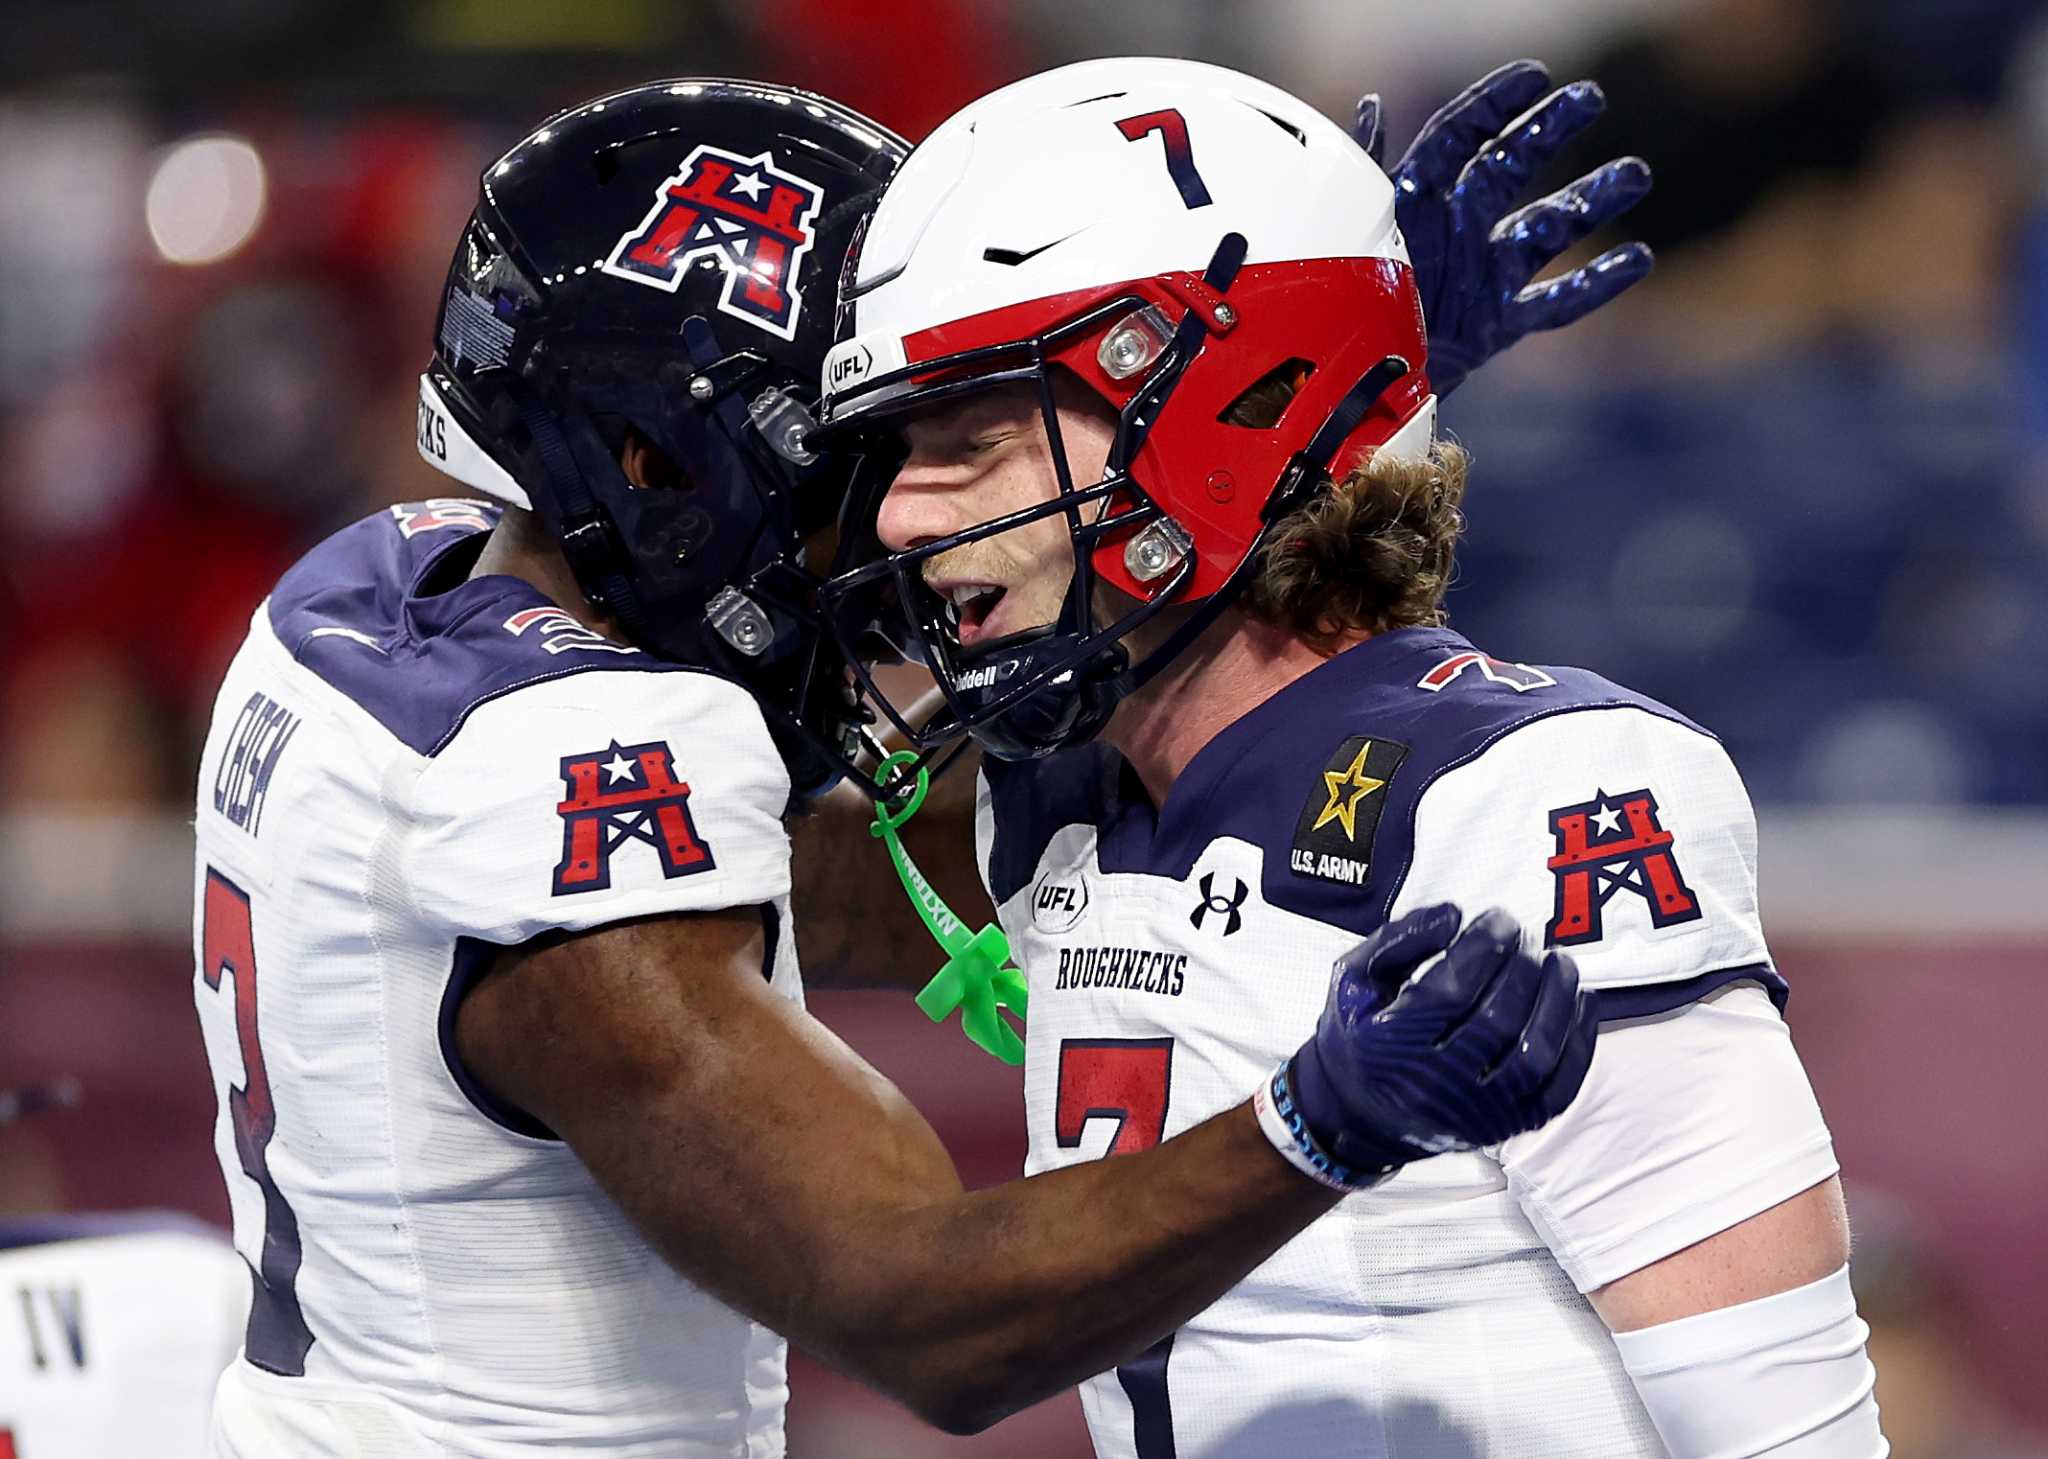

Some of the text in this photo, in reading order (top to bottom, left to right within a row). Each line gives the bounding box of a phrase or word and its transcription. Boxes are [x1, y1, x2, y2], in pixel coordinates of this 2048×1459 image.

[1113, 108, 1214, 210] 7
[834, 355, 863, 382] UFL
[1416, 652, 1558, 692] 7
[1291, 849, 1369, 885] U.S. ARMY
[1037, 886, 1076, 912] UFL
[1055, 946, 1188, 997] ROUGHNECKS
[202, 862, 317, 1377] 3
[17, 1280, 88, 1373] IV
